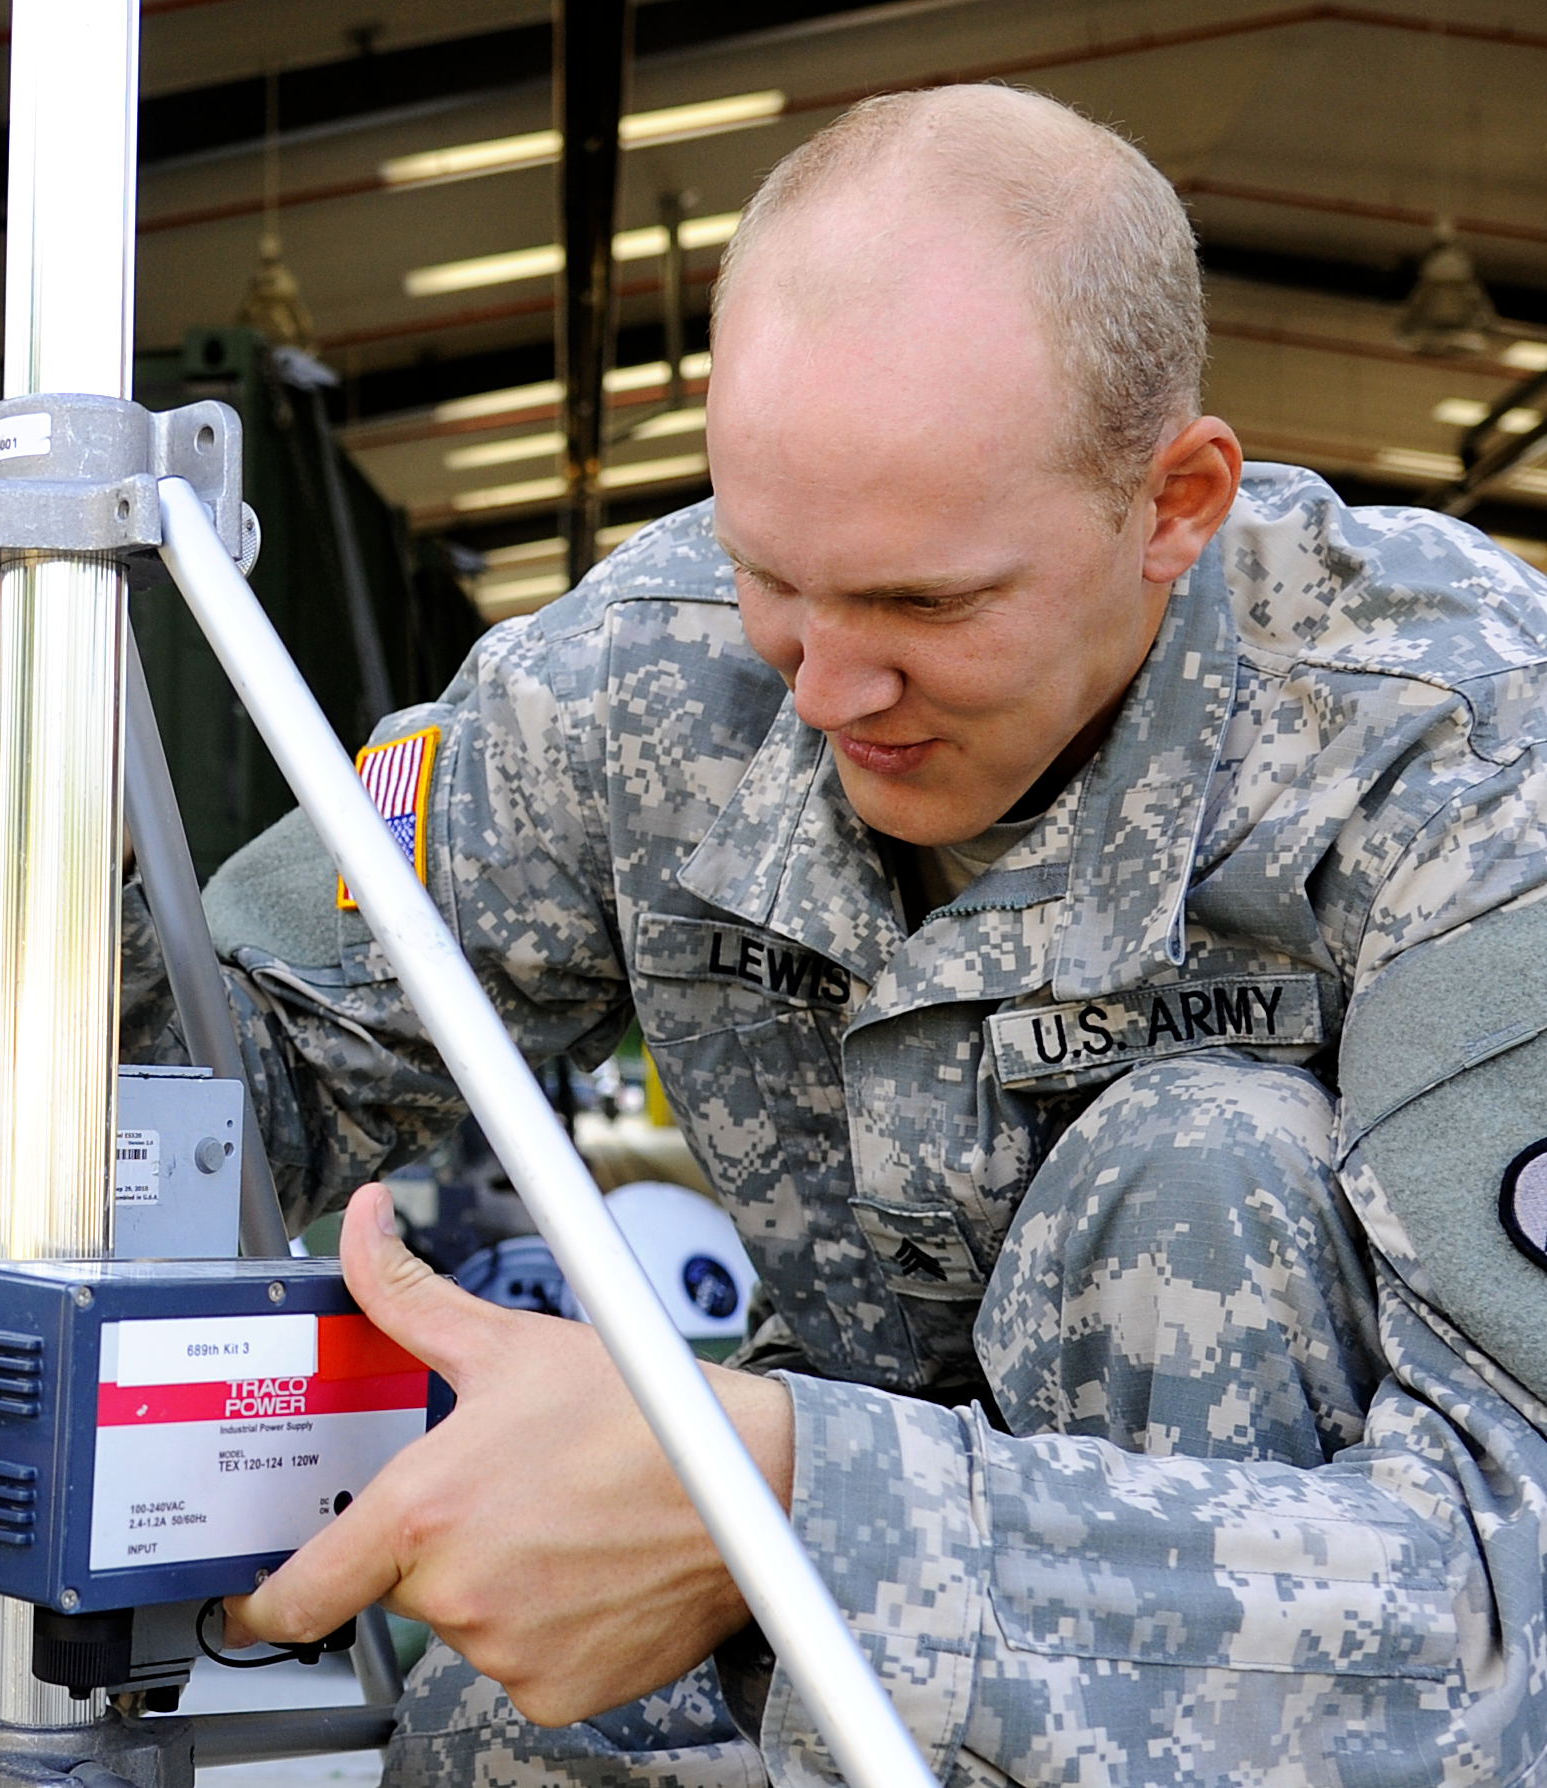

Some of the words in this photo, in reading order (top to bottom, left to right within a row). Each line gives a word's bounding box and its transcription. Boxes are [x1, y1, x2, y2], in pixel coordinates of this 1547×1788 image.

[709, 932, 851, 1004] LEWIS
[1031, 1005, 1128, 1064] U.S.
[1147, 986, 1284, 1047] ARMY
[187, 1343, 219, 1357] 689th
[223, 1343, 239, 1355] Kit
[242, 1342, 250, 1354] 3
[226, 1377, 308, 1398] TRACO
[225, 1396, 306, 1417] POWER
[220, 1423, 257, 1435] Industrial
[259, 1422, 284, 1432] Power
[286, 1420, 313, 1432] Supply
[219, 1450, 245, 1459] MODEL
[218, 1460, 240, 1472] TEX
[244, 1457, 283, 1471] 120-124
[291, 1454, 320, 1467] 120W
[131, 1500, 185, 1514] 100-240VAC
[129, 1516, 167, 1529] 2.4-1.2A
[171, 1513, 207, 1526] 50/60Hz
[128, 1543, 157, 1555] INPUT
